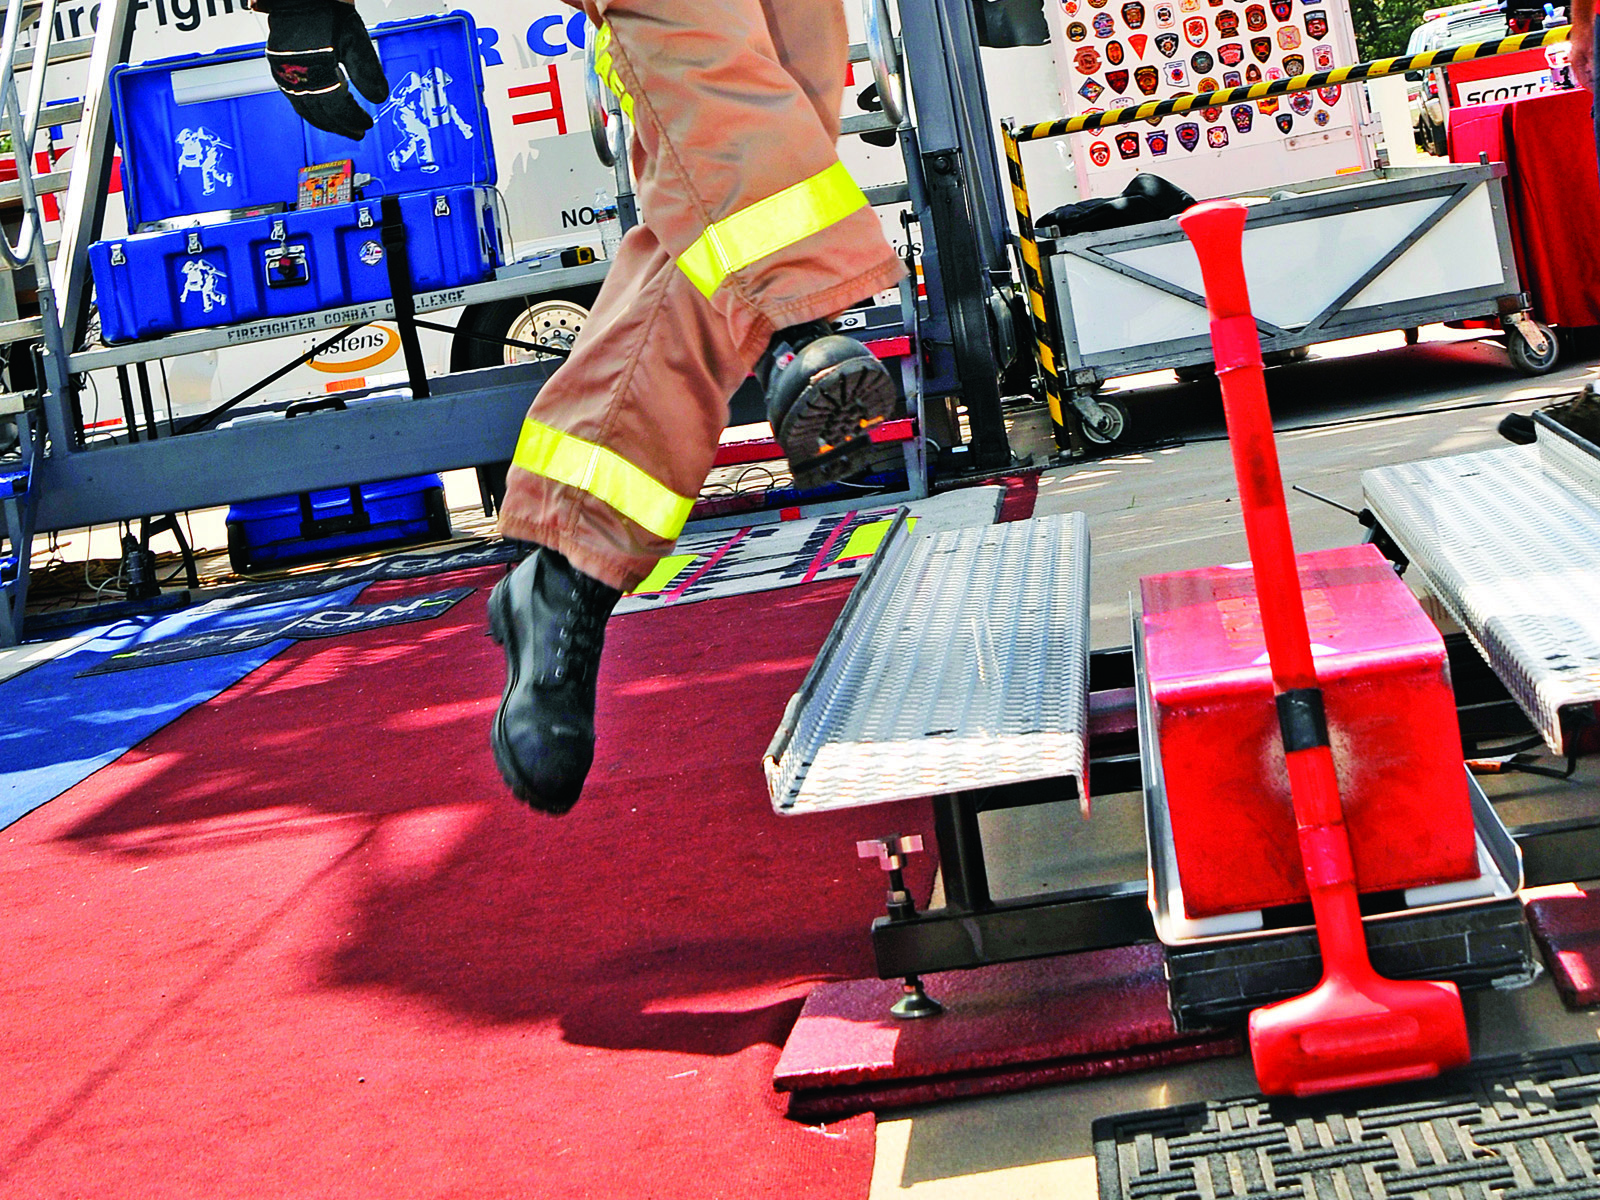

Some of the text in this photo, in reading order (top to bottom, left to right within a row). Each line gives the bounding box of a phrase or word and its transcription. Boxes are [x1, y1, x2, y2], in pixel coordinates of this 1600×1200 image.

[1467, 83, 1537, 106] SCOTT
[227, 317, 316, 343] FIREFIGHTER
[324, 306, 378, 324] COMBAT
